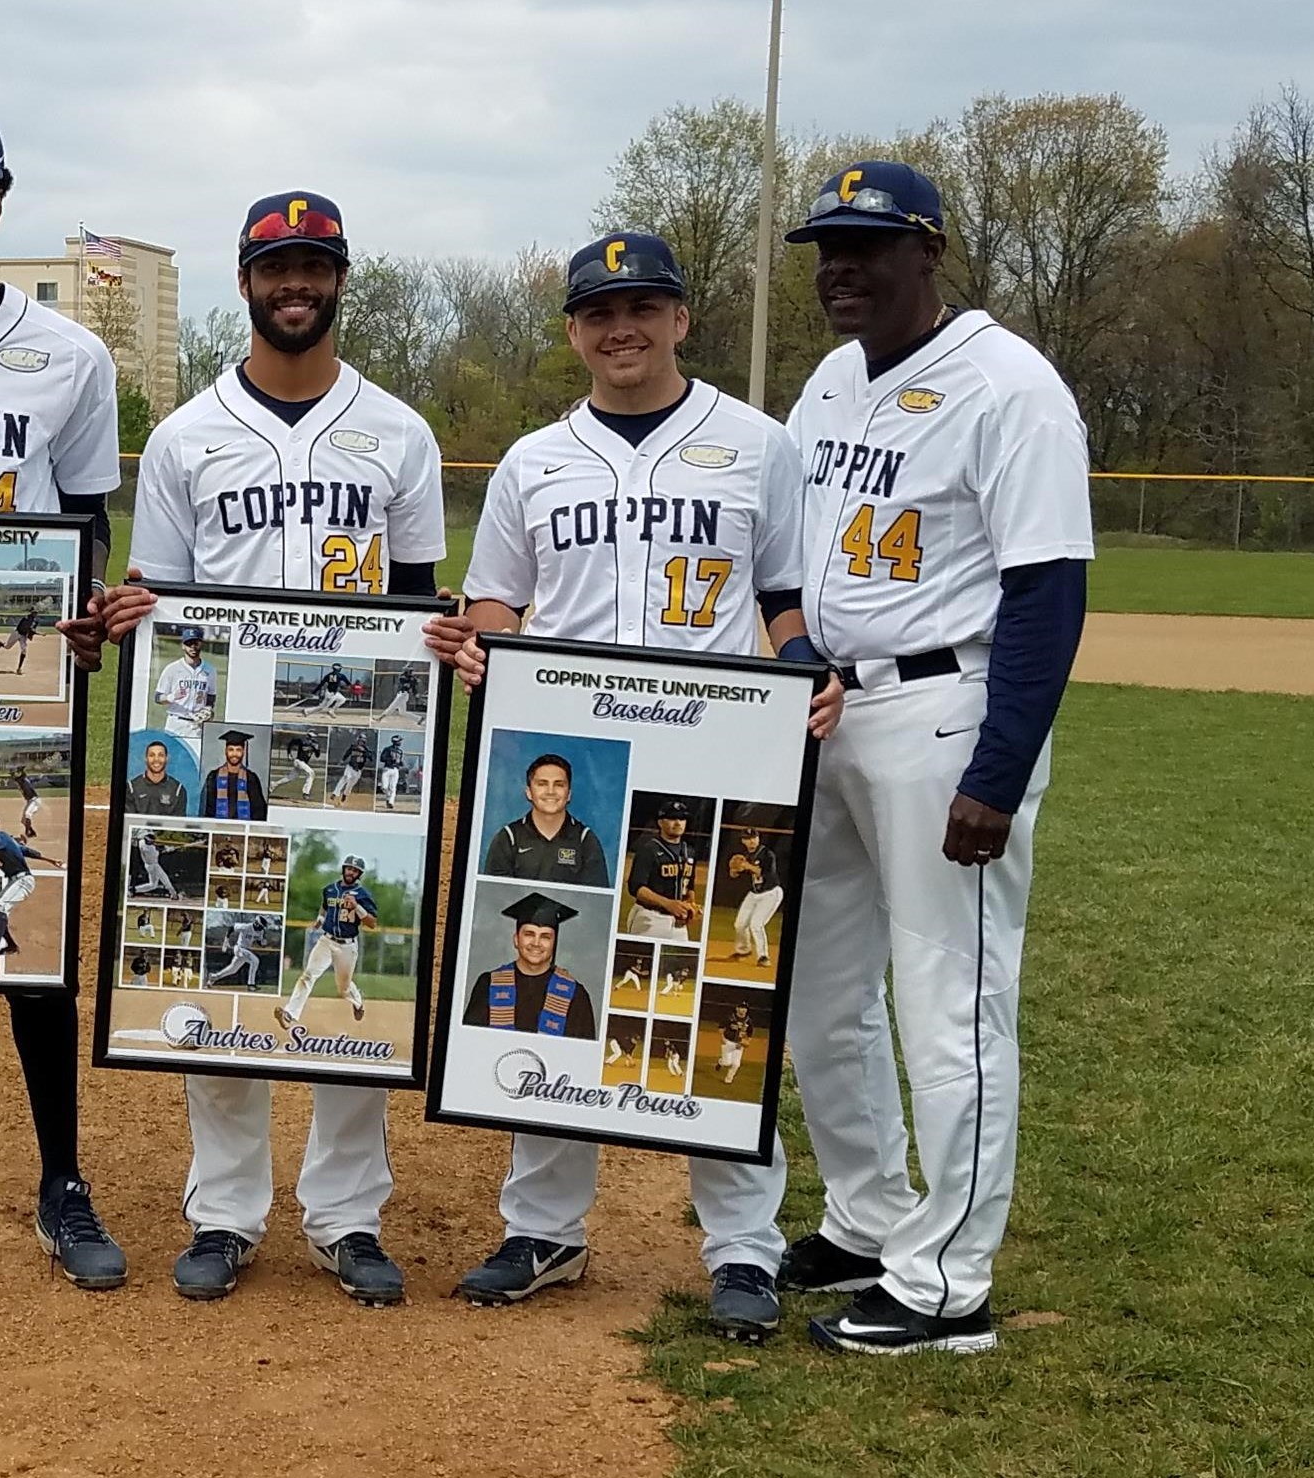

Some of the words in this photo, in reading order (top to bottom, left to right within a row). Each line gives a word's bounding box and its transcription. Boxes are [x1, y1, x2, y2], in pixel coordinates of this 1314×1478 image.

[838, 169, 864, 204] C
[605, 239, 626, 273] C
[807, 439, 906, 499] COPPIN
[217, 481, 373, 535] COPPIN
[550, 496, 722, 552] COPPIN
[320, 533, 384, 595] 24
[841, 503, 924, 583] 44
[660, 556, 734, 628] 17
[183, 606, 246, 624] COPPIN
[248, 609, 300, 628] STATE
[303, 612, 406, 634] UNIVERSITY
[238, 622, 346, 652] Baseball
[536, 668, 602, 690] COPPIN
[603, 674, 659, 695] STATE
[661, 679, 771, 705] UNIVERSITY
[592, 692, 708, 727] Baseball
[178, 1018, 280, 1052] Andres
[283, 1025, 397, 1060] Santana
[516, 1069, 613, 1109] Palmer
[615, 1082, 704, 1121] Powis
